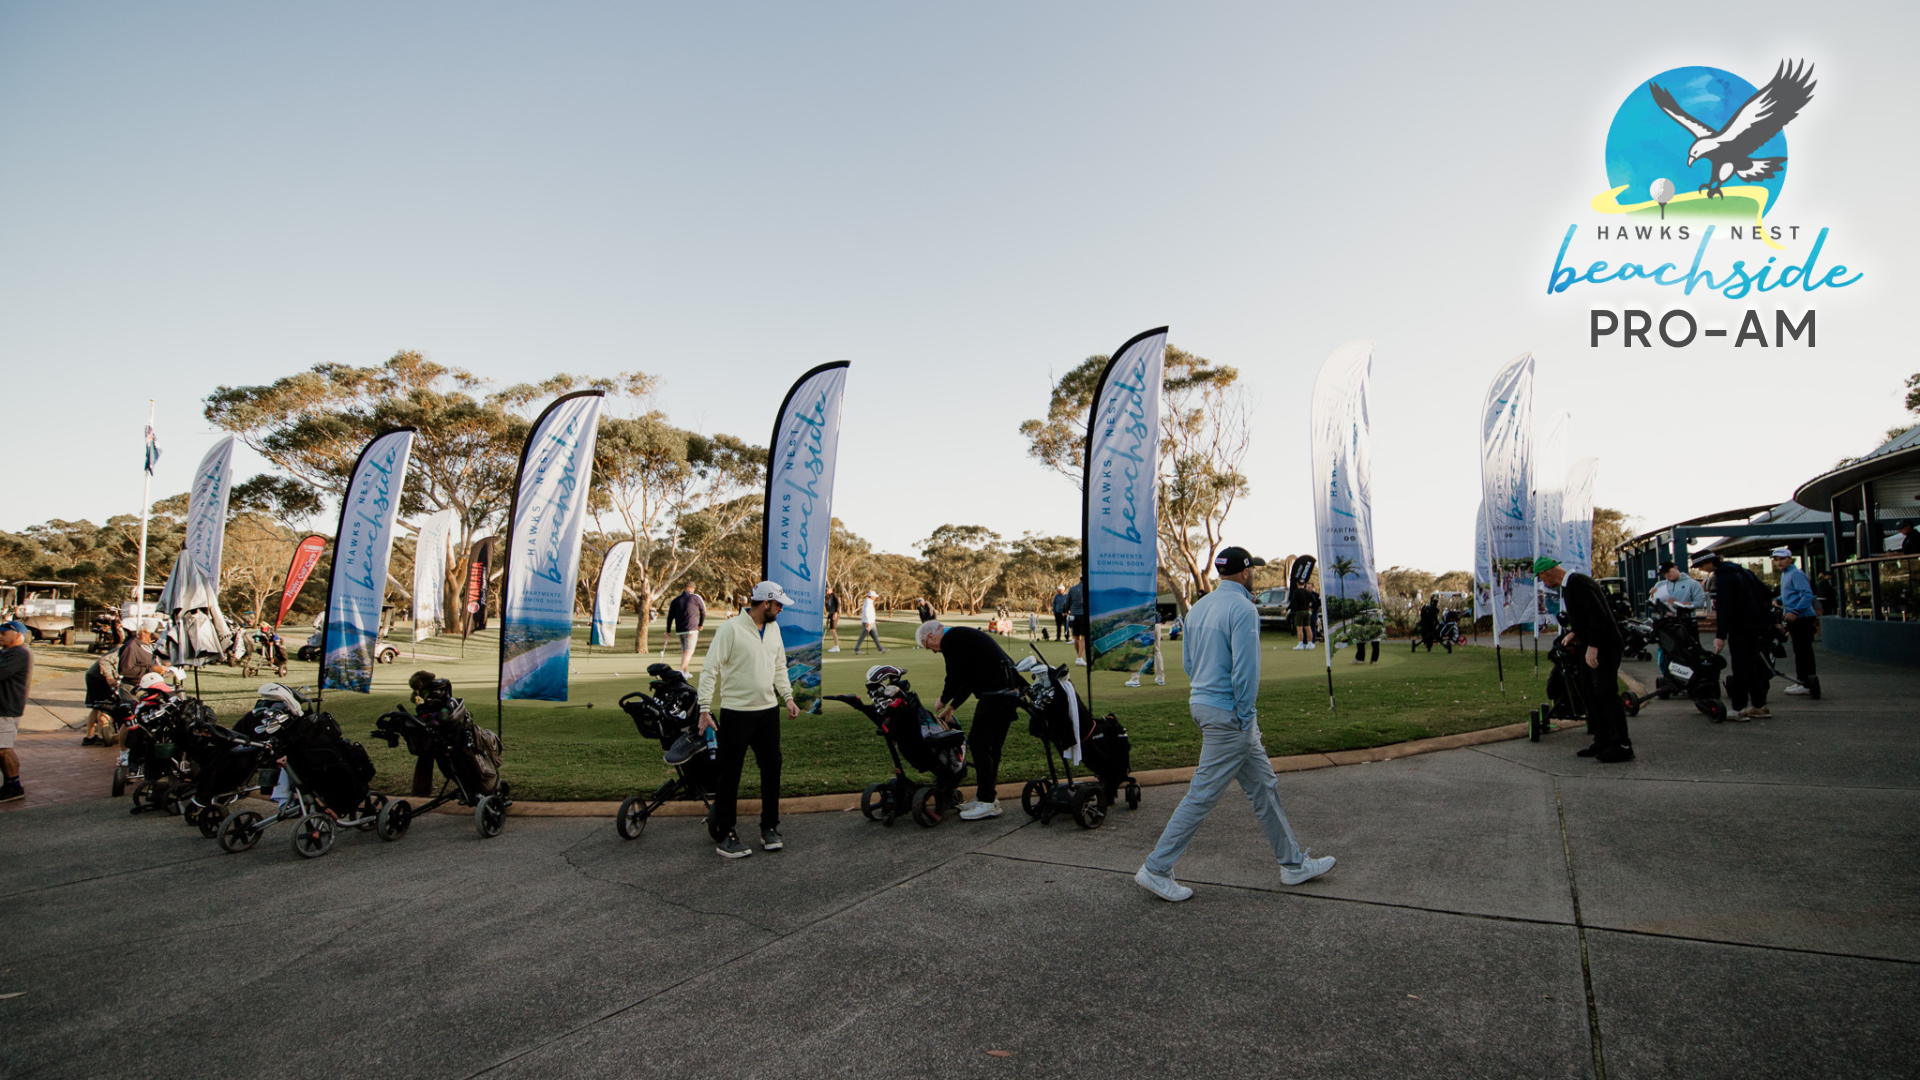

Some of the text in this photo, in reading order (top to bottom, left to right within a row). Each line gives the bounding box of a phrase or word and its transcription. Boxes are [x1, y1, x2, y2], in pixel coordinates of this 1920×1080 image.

[525, 416, 578, 585] beachside
[527, 448, 549, 556] HAWKS NEST
[780, 390, 827, 582] beachside
[781, 428, 799, 550] HAWKS NEST
[1101, 357, 1148, 545] beachside
[1102, 397, 1118, 515] HAWKS NEST
[344, 446, 396, 591] beachside
[346, 472, 372, 565] HAWKS NEST
[468, 562, 483, 602] YAMAHA
[783, 588, 811, 597] PARTMENTS
